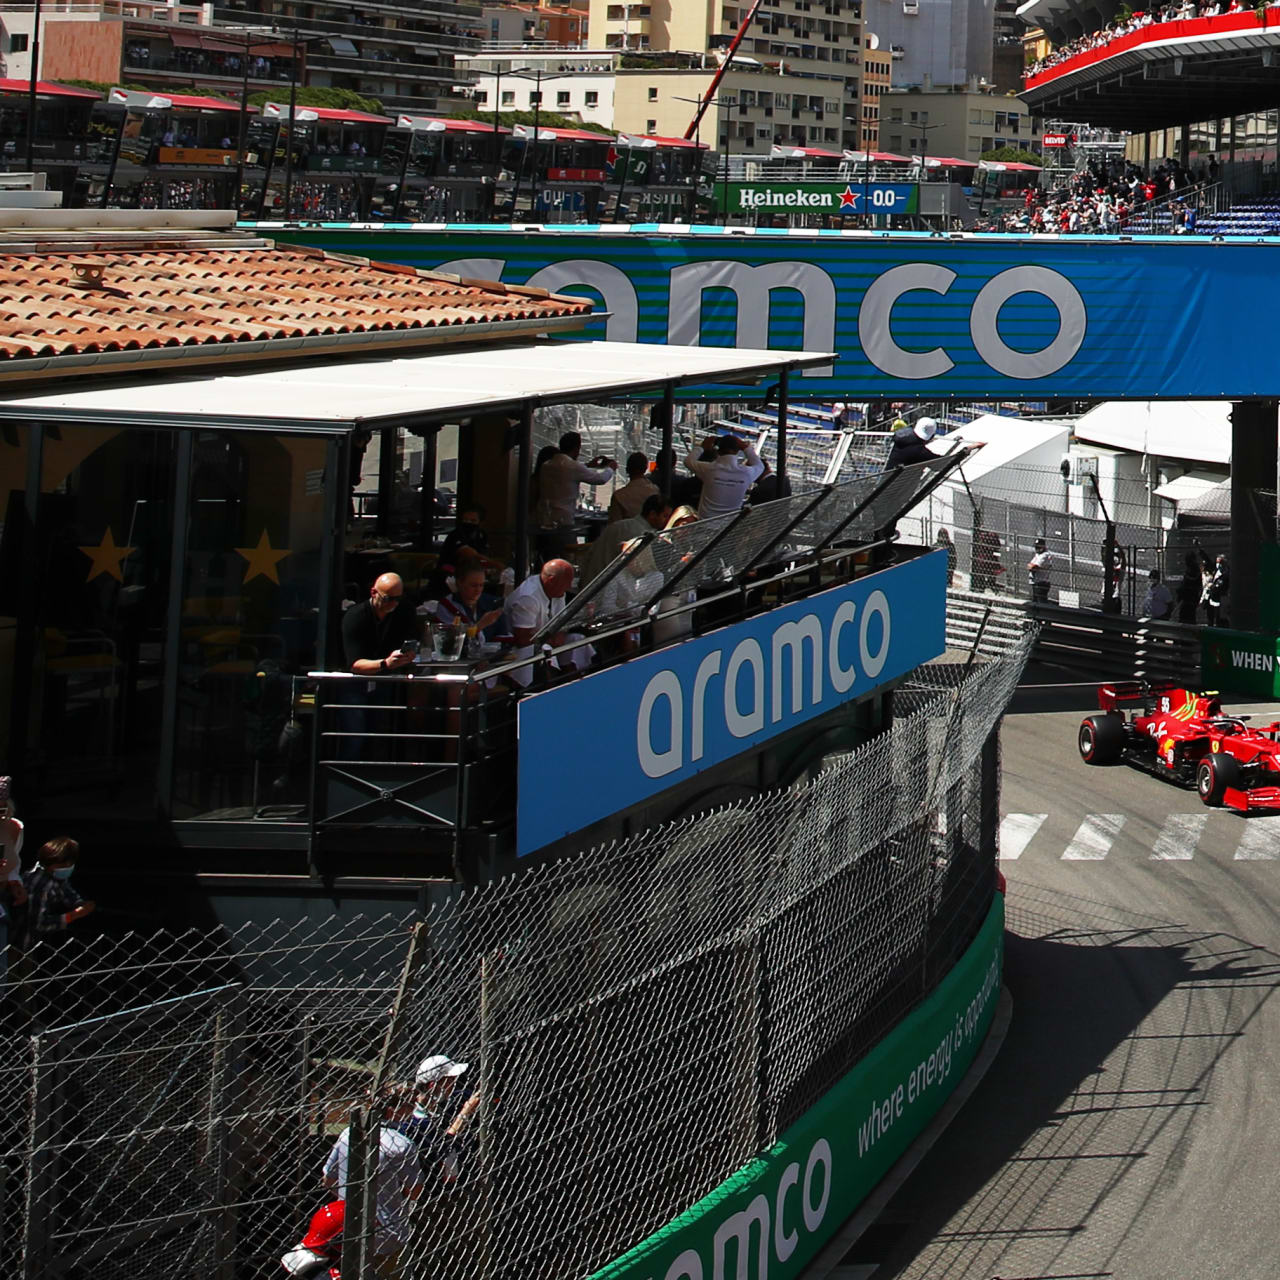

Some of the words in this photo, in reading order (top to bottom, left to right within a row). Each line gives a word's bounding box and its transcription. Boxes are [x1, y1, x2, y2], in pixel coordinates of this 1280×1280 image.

[739, 188, 833, 207] Heineken
[636, 589, 892, 779] aramco
[1231, 649, 1273, 672] WHEN
[857, 1083, 904, 1158] where
[908, 1029, 953, 1104] energy
